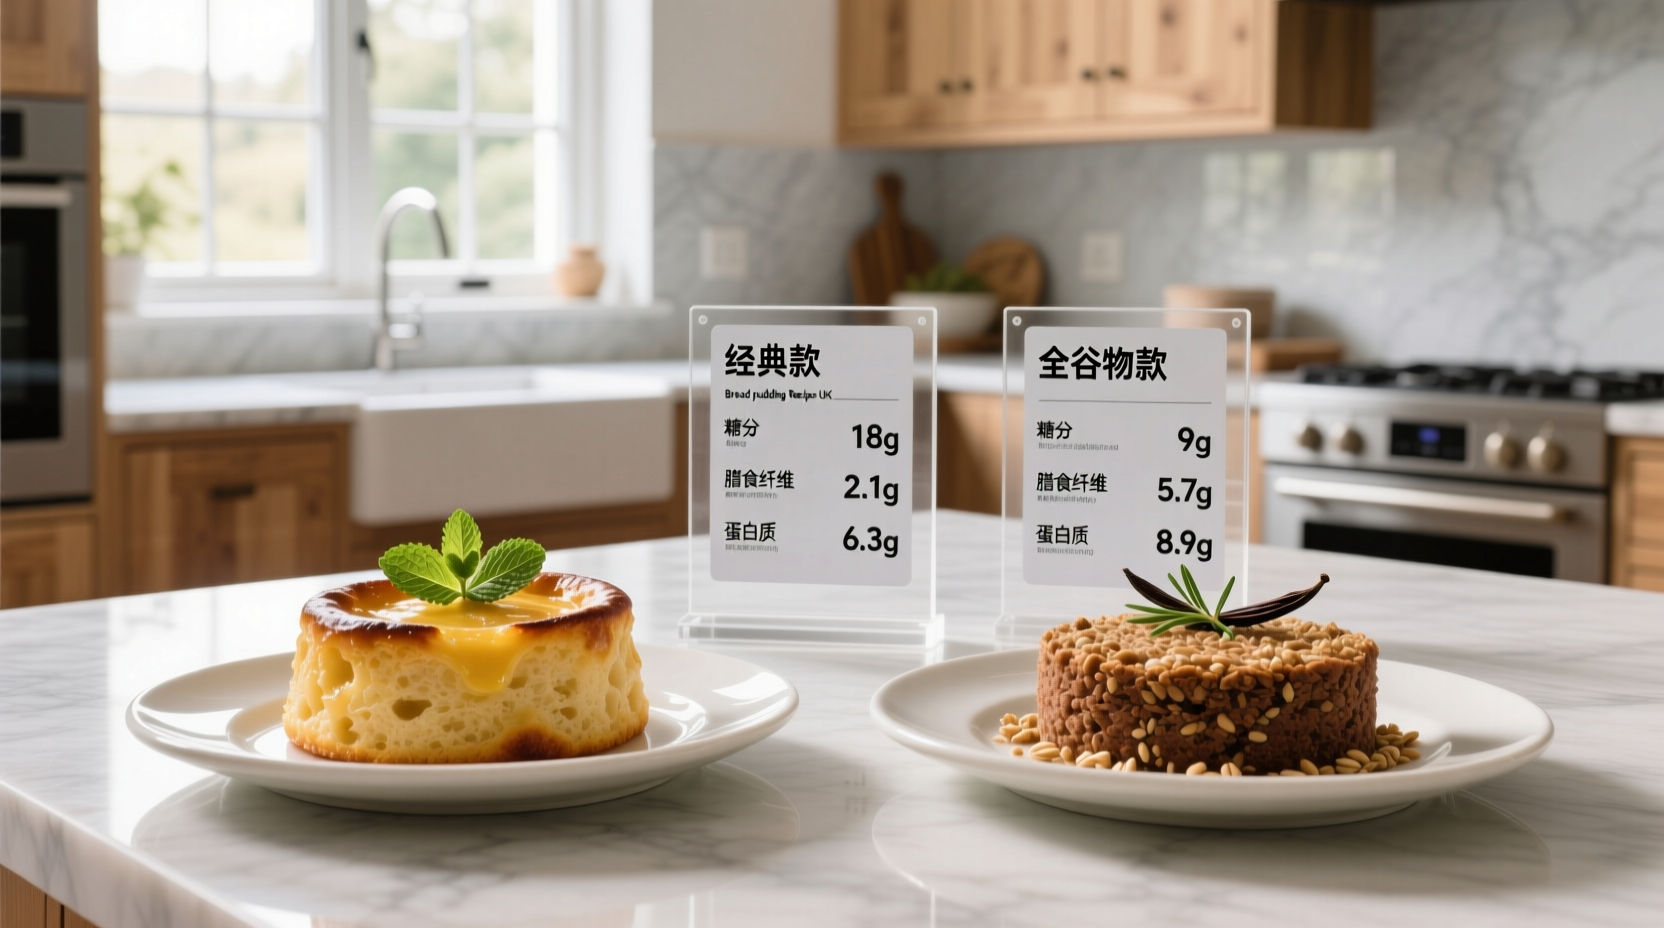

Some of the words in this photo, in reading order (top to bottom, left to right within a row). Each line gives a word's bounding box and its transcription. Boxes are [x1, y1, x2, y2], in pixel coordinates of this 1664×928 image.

[725, 343, 820, 378] 经典款
[1039, 345, 1167, 381] 全谷物款
[819, 390, 833, 400] UK
[724, 418, 760, 437] 糖分
[852, 424, 899, 456] 18g
[1036, 420, 1073, 440] 糖分
[1177, 427, 1212, 459] 9g
[844, 474, 899, 507] 2.1g
[1157, 477, 1213, 510] 5.7g
[724, 521, 776, 542] 蛋白质
[843, 526, 899, 558] 6.3g
[1036, 525, 1089, 545] 蛋白质
[1156, 529, 1213, 562] 8.9g
